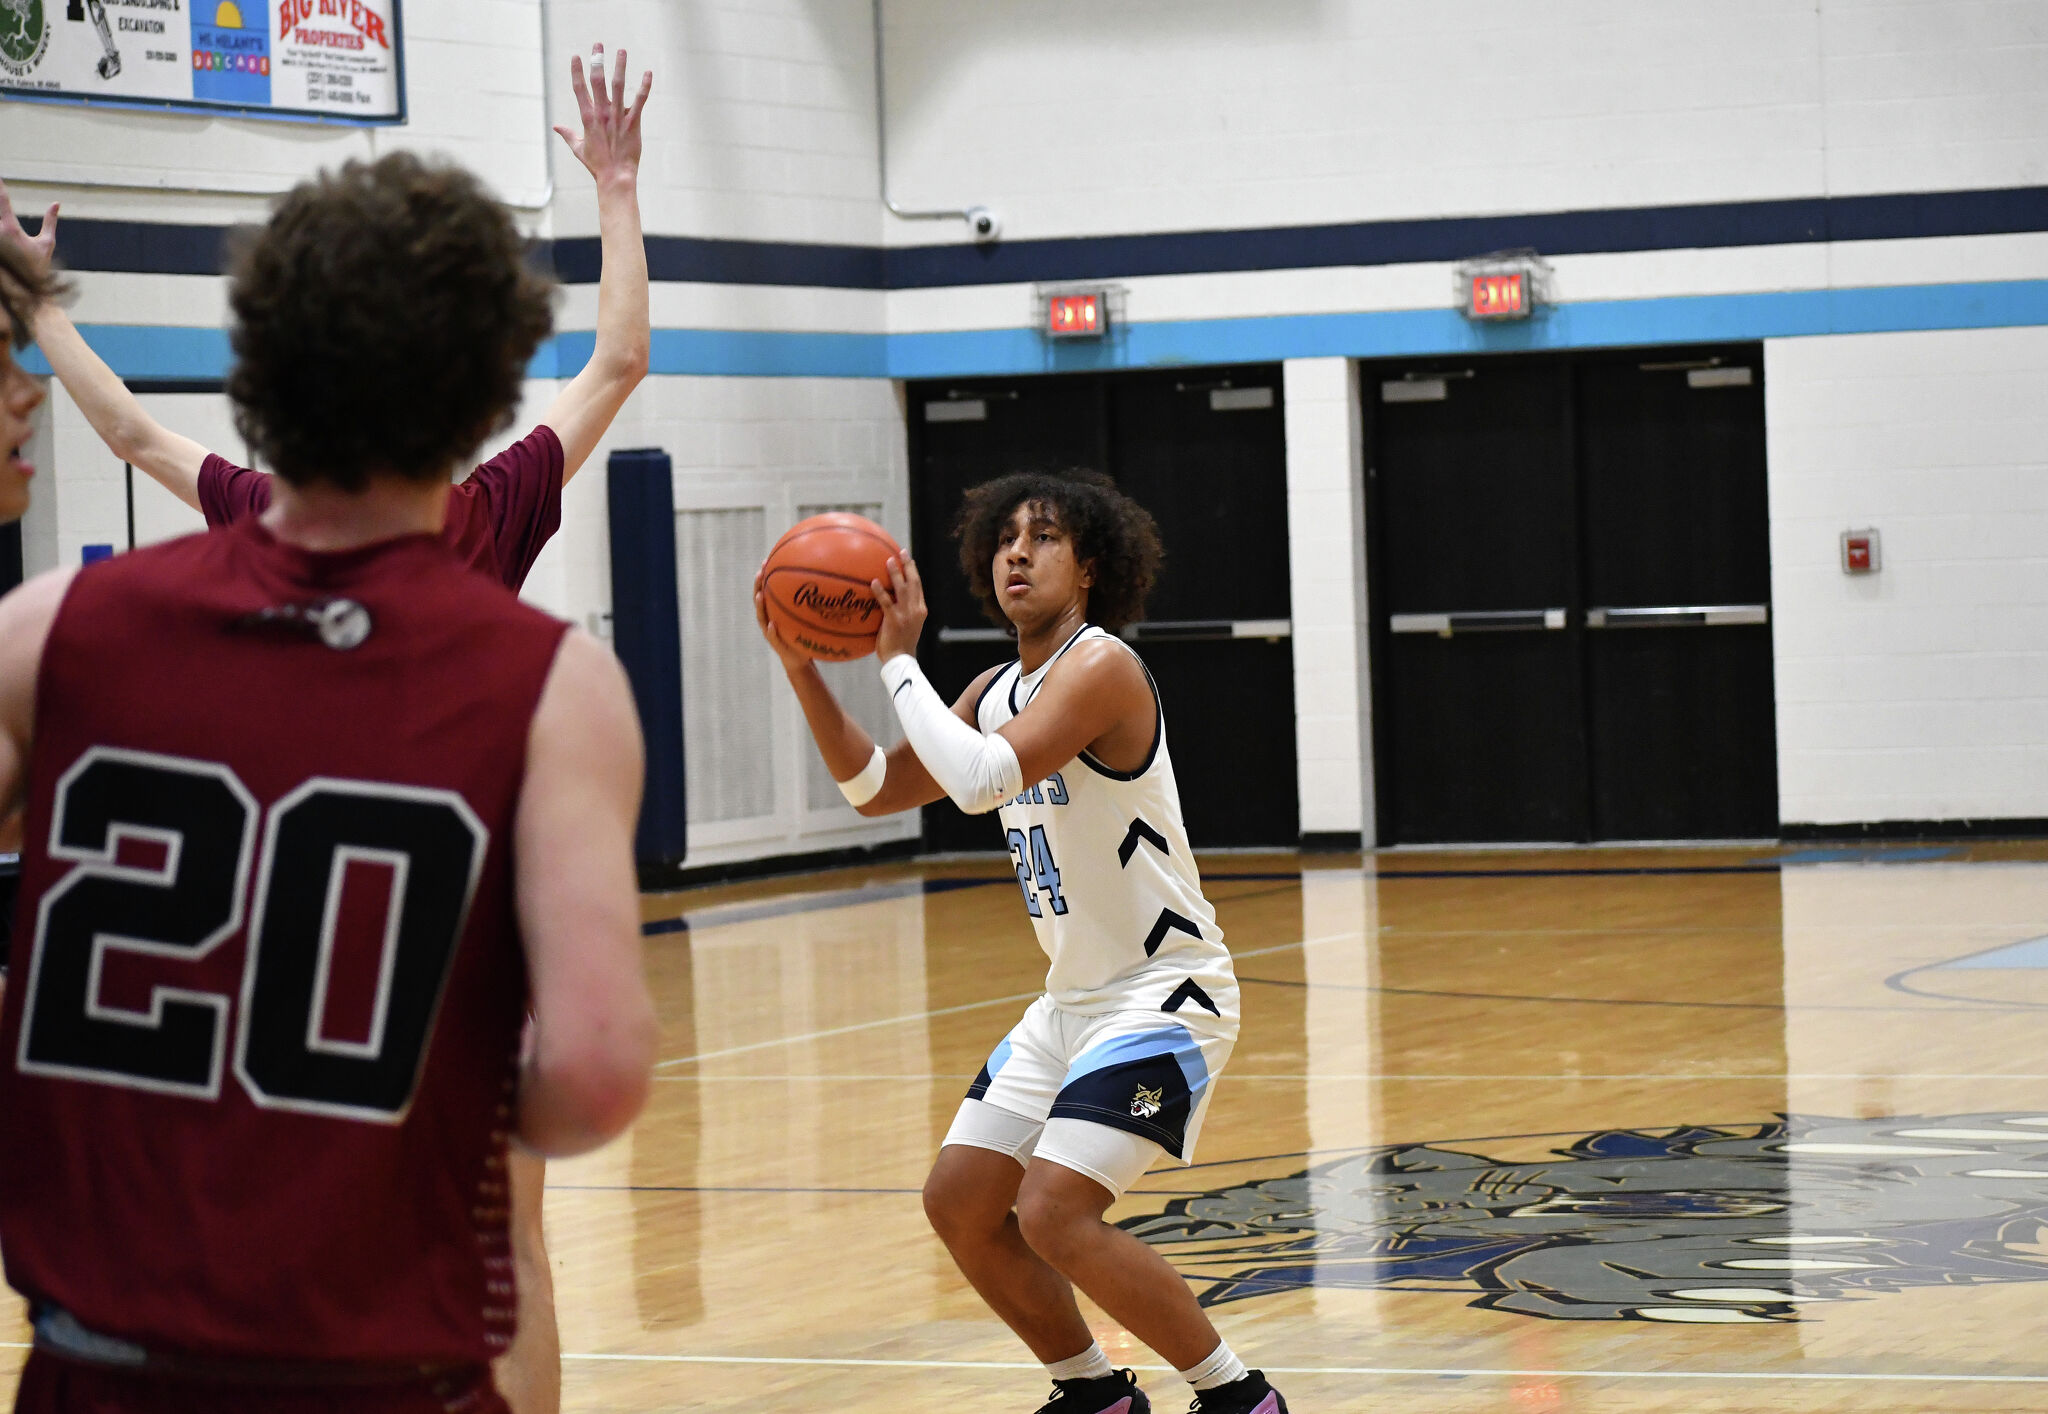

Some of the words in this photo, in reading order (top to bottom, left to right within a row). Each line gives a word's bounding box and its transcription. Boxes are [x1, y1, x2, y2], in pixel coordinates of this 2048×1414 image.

[279, 0, 312, 40] BIG
[294, 28, 365, 50] PROPERTIES
[1006, 824, 1069, 918] 24
[17, 745, 490, 1126] 20
